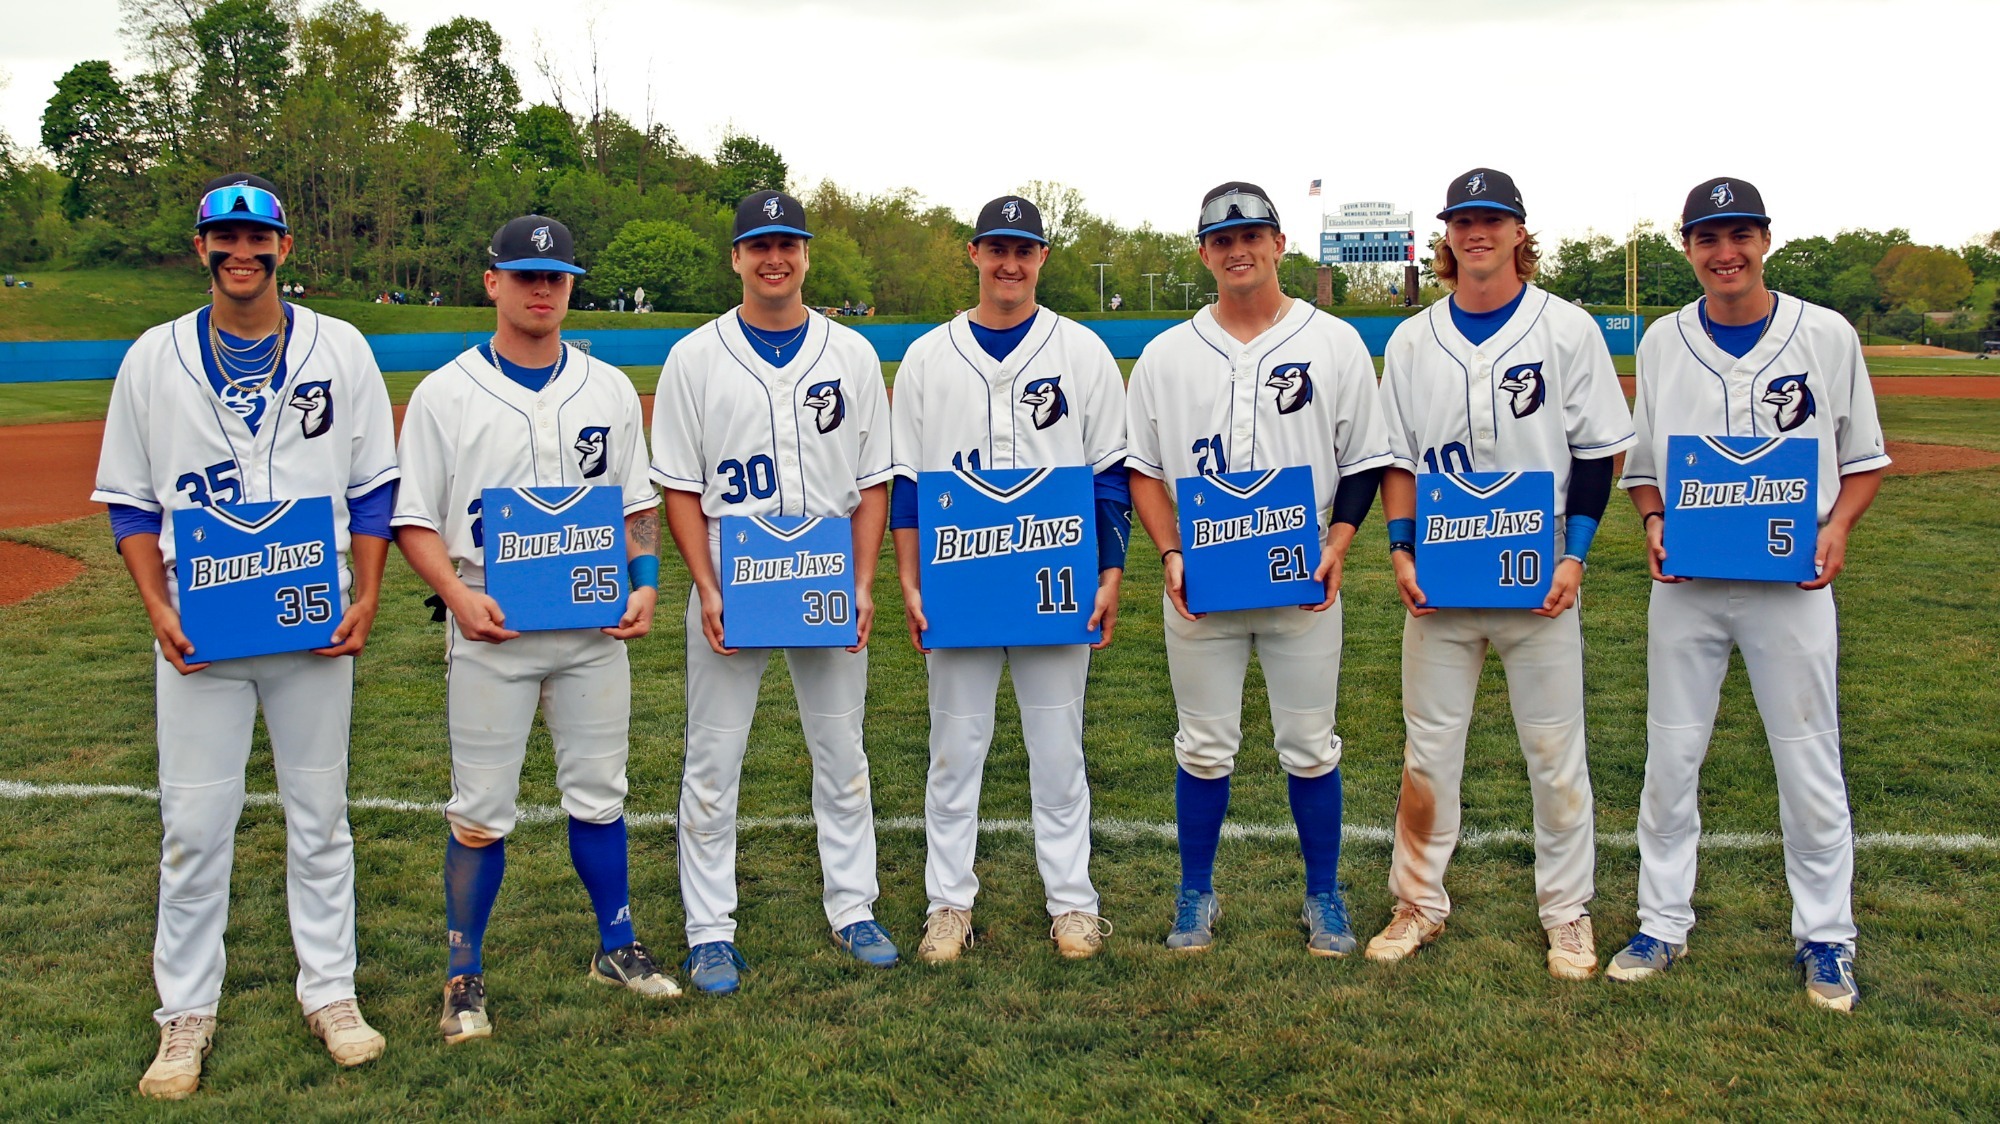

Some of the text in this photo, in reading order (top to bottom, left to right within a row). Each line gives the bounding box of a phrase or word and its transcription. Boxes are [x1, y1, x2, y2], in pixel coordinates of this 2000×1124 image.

[1365, 219, 1384, 227] College
[1606, 317, 1630, 330] 320
[1192, 434, 1227, 476] 21
[1424, 441, 1473, 474] 10
[176, 459, 241, 507] 35
[717, 454, 777, 504] 30
[1768, 518, 1794, 557] 5
[1268, 544, 1310, 583] 21
[1499, 550, 1540, 586] 10
[571, 565, 619, 603] 25
[1036, 566, 1078, 614] 11
[275, 582, 332, 627] 35
[802, 590, 849, 626] 30
